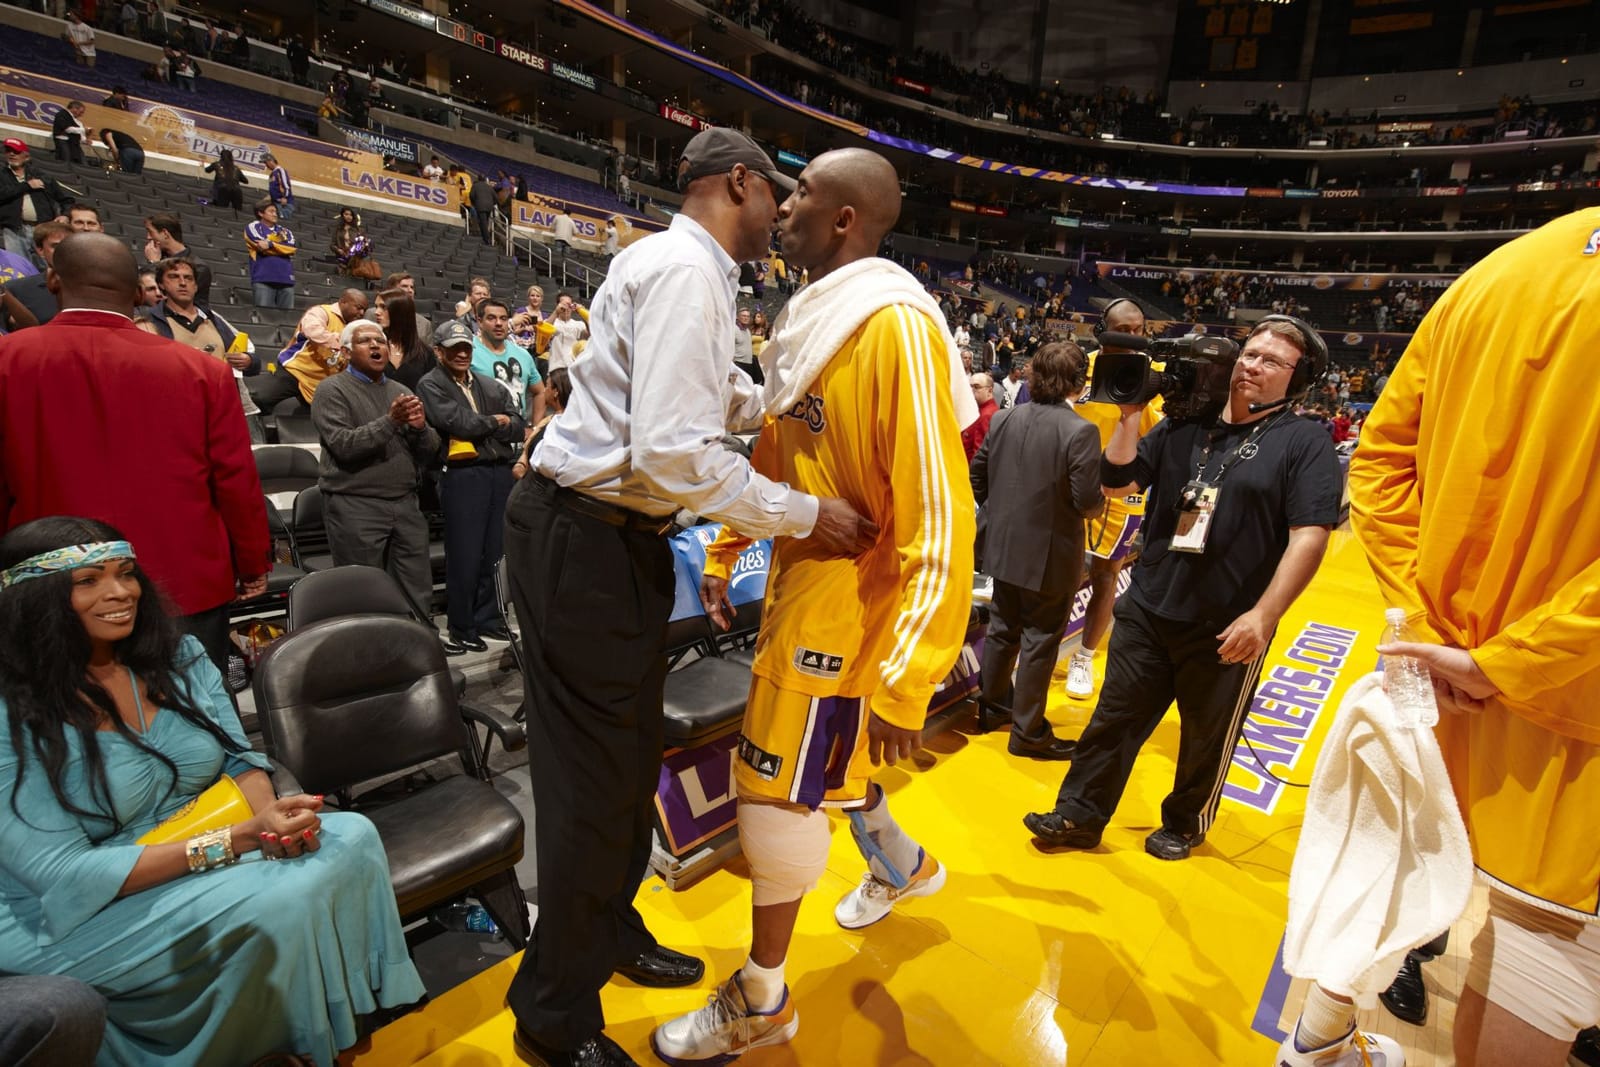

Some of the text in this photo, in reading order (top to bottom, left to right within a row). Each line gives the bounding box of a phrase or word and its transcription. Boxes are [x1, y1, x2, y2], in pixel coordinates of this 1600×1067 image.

[501, 43, 545, 71] STAPLES
[369, 136, 414, 155] MANUEL
[342, 167, 448, 205] LAKERS
[1322, 190, 1359, 198] TOYOTA
[520, 207, 597, 237] LAKRS
[1220, 620, 1360, 817] LAKERS.COM
